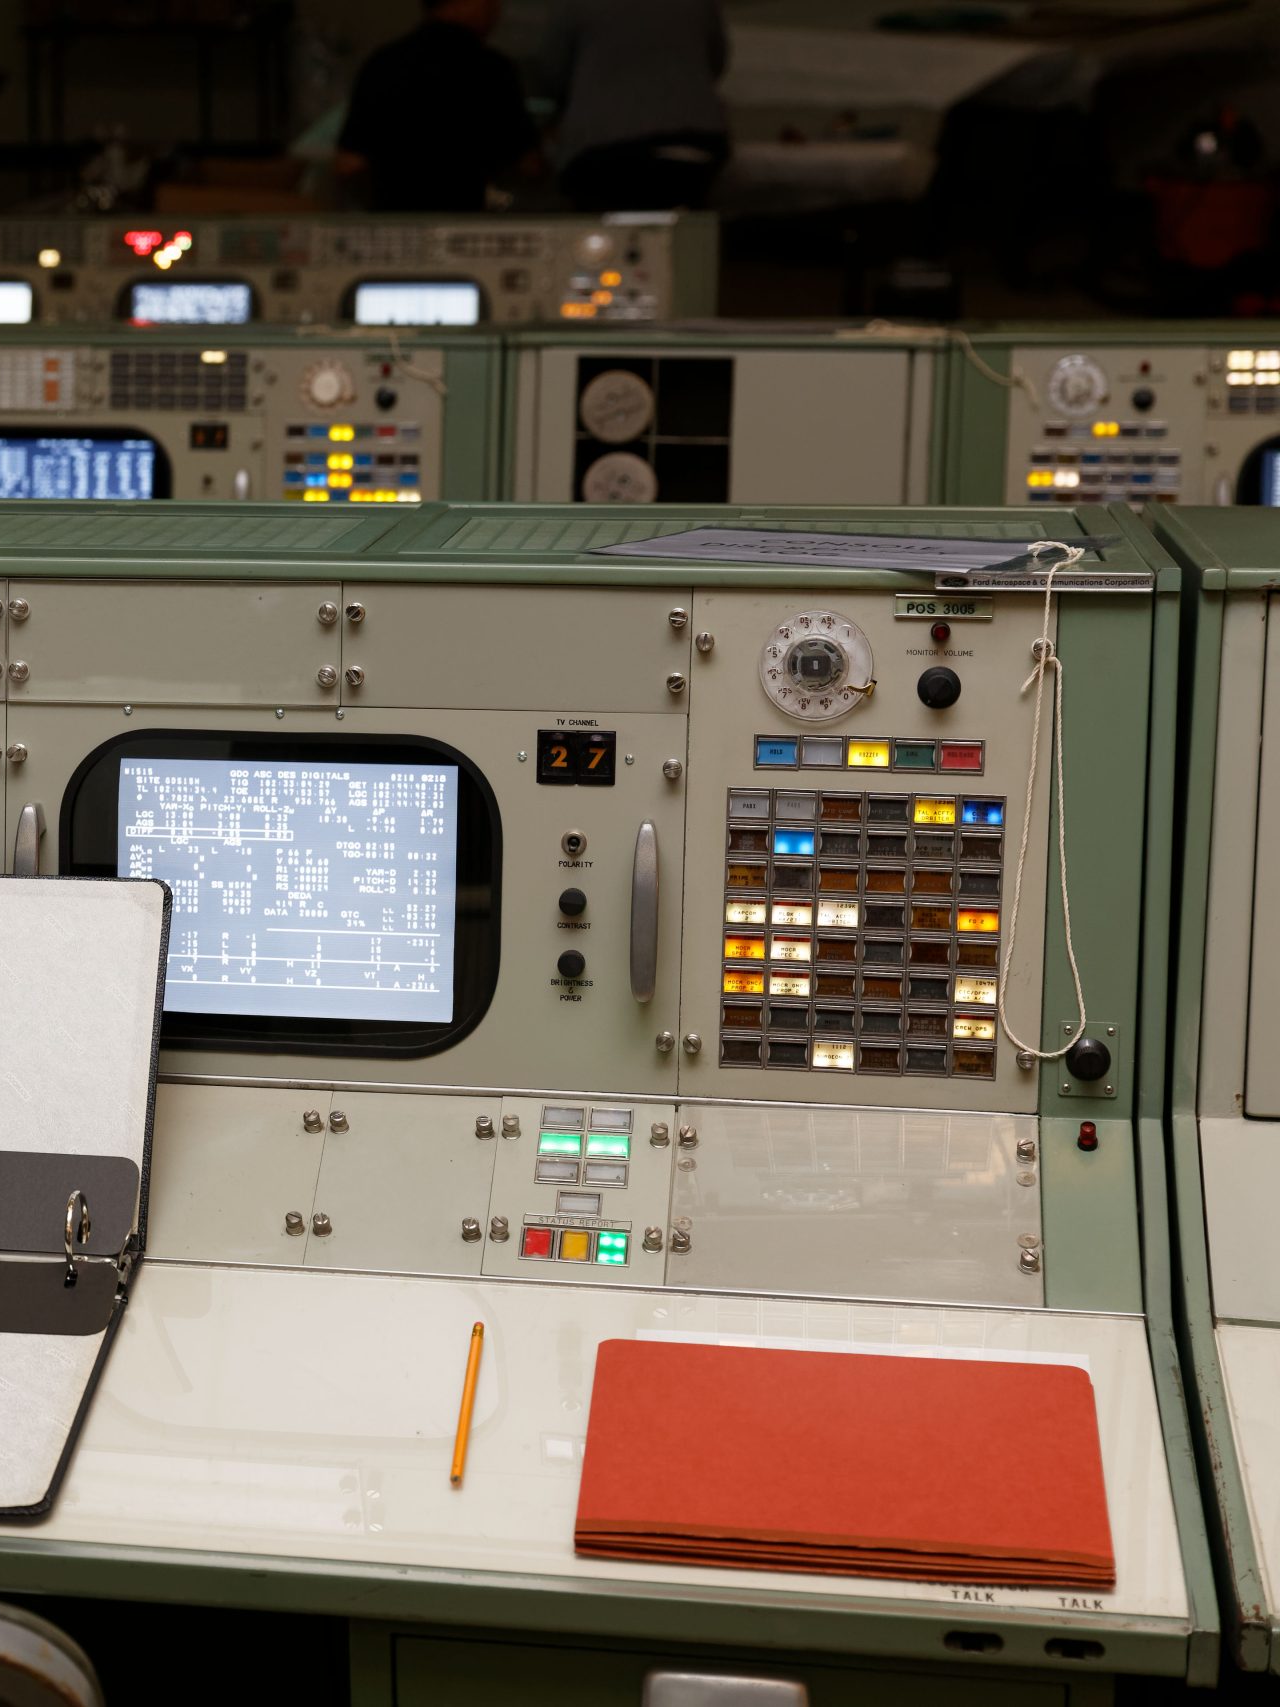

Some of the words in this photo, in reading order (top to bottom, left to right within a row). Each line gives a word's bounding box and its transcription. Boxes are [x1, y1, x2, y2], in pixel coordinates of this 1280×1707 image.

[992, 579, 1031, 588] Aerospace
[1105, 578, 1150, 588] Corporation
[906, 603, 935, 615] POS
[944, 603, 976, 615] 3005
[906, 649, 938, 657] MONITOR
[569, 719, 598, 727] CHANNEL
[551, 746, 568, 768] 2
[588, 748, 607, 769] 7
[302, 772, 350, 780] DIGITALS
[349, 799, 367, 807] AGS
[354, 877, 396, 885] PITCH-D
[359, 886, 396, 894] ROLL-D
[288, 892, 312, 900] DEDA
[264, 908, 288, 916] DATA
[550, 979, 594, 987] BRIGHTNESS
[538, 1216, 574, 1226] STATUS
[580, 1219, 614, 1228] REPORT
[952, 1590, 995, 1603] TALK
[1058, 1597, 1103, 1610] TALK
